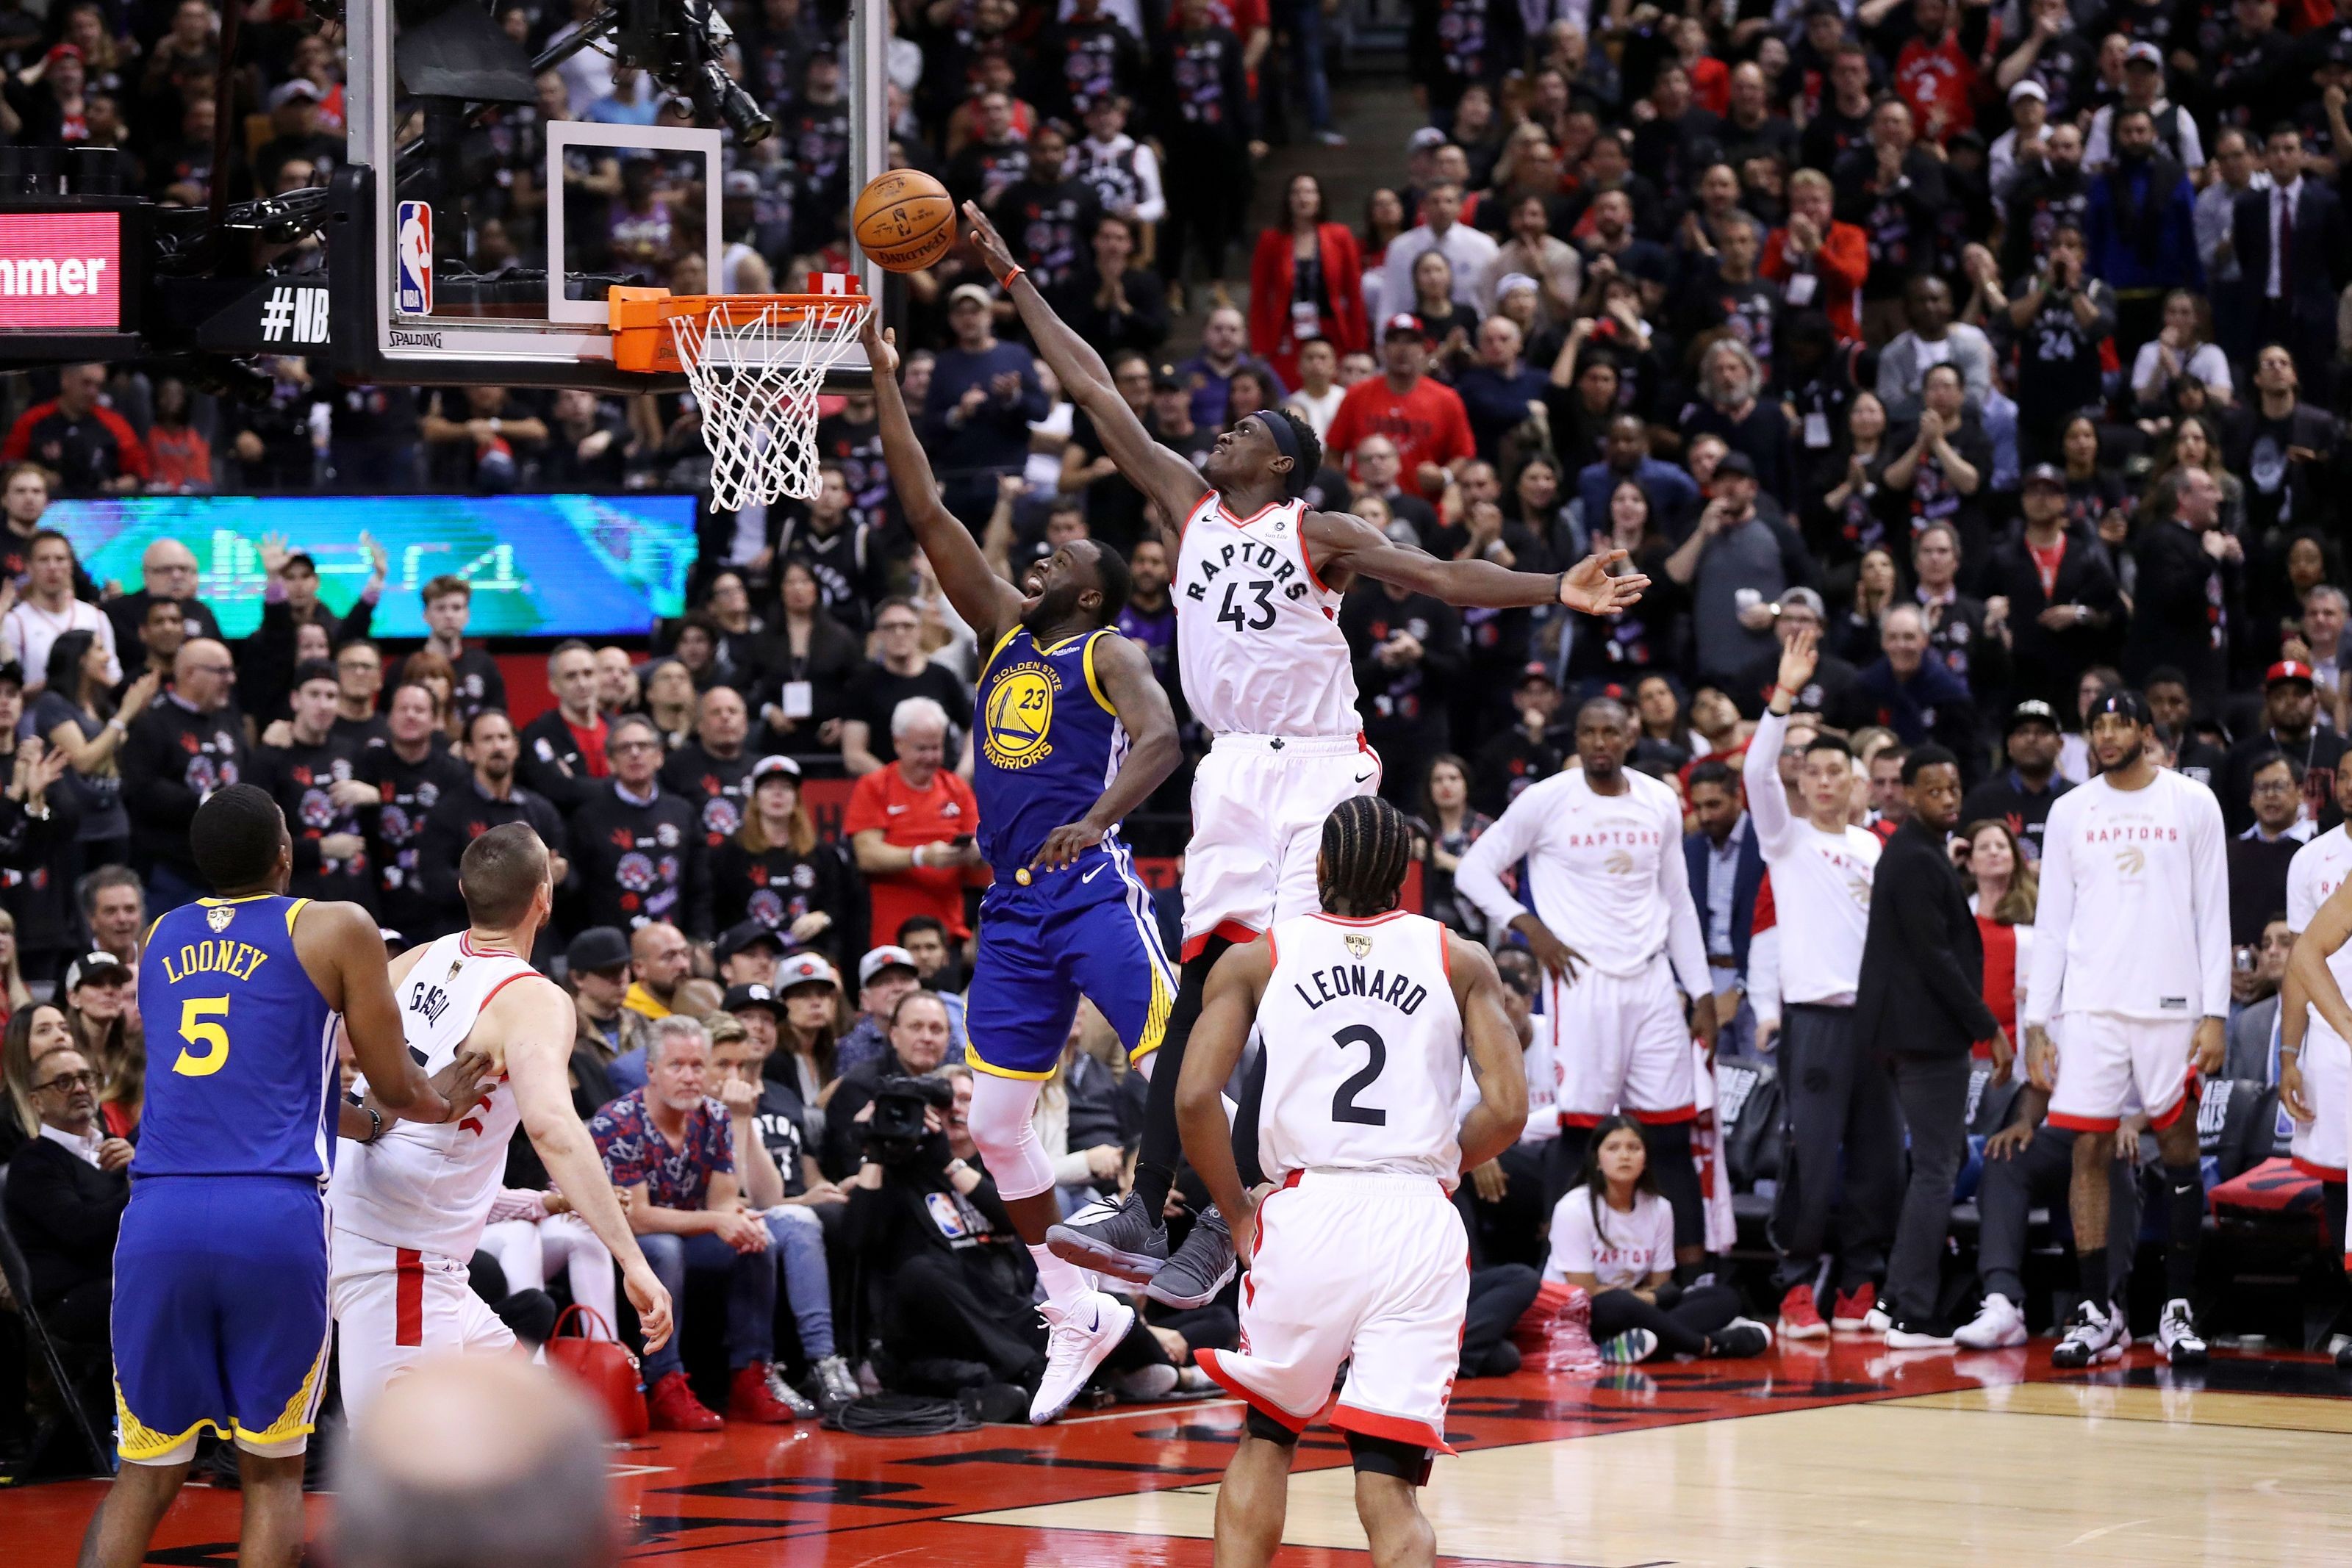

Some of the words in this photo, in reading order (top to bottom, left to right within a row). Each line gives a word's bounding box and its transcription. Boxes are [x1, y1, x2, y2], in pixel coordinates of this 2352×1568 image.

[878, 227, 947, 265] SPALDING
[260, 287, 331, 343] #NB
[403, 289, 420, 308] NBA
[389, 331, 442, 348] SPALDING
[1186, 542, 1308, 603] RAPTORS
[1217, 580, 1277, 632] 43
[992, 661, 1041, 683] GOLDEN
[1041, 663, 1063, 692] STATE
[1019, 688, 1047, 710] 23
[982, 737, 1054, 769] WARRIORS
[2084, 826, 2177, 844] RAPTORS
[162, 939, 268, 984] LOONEY
[409, 982, 451, 1029] GASOL
[1294, 964, 1427, 1015] LEONARD
[172, 993, 230, 1077] 5
[1332, 1024, 1386, 1126] 2
